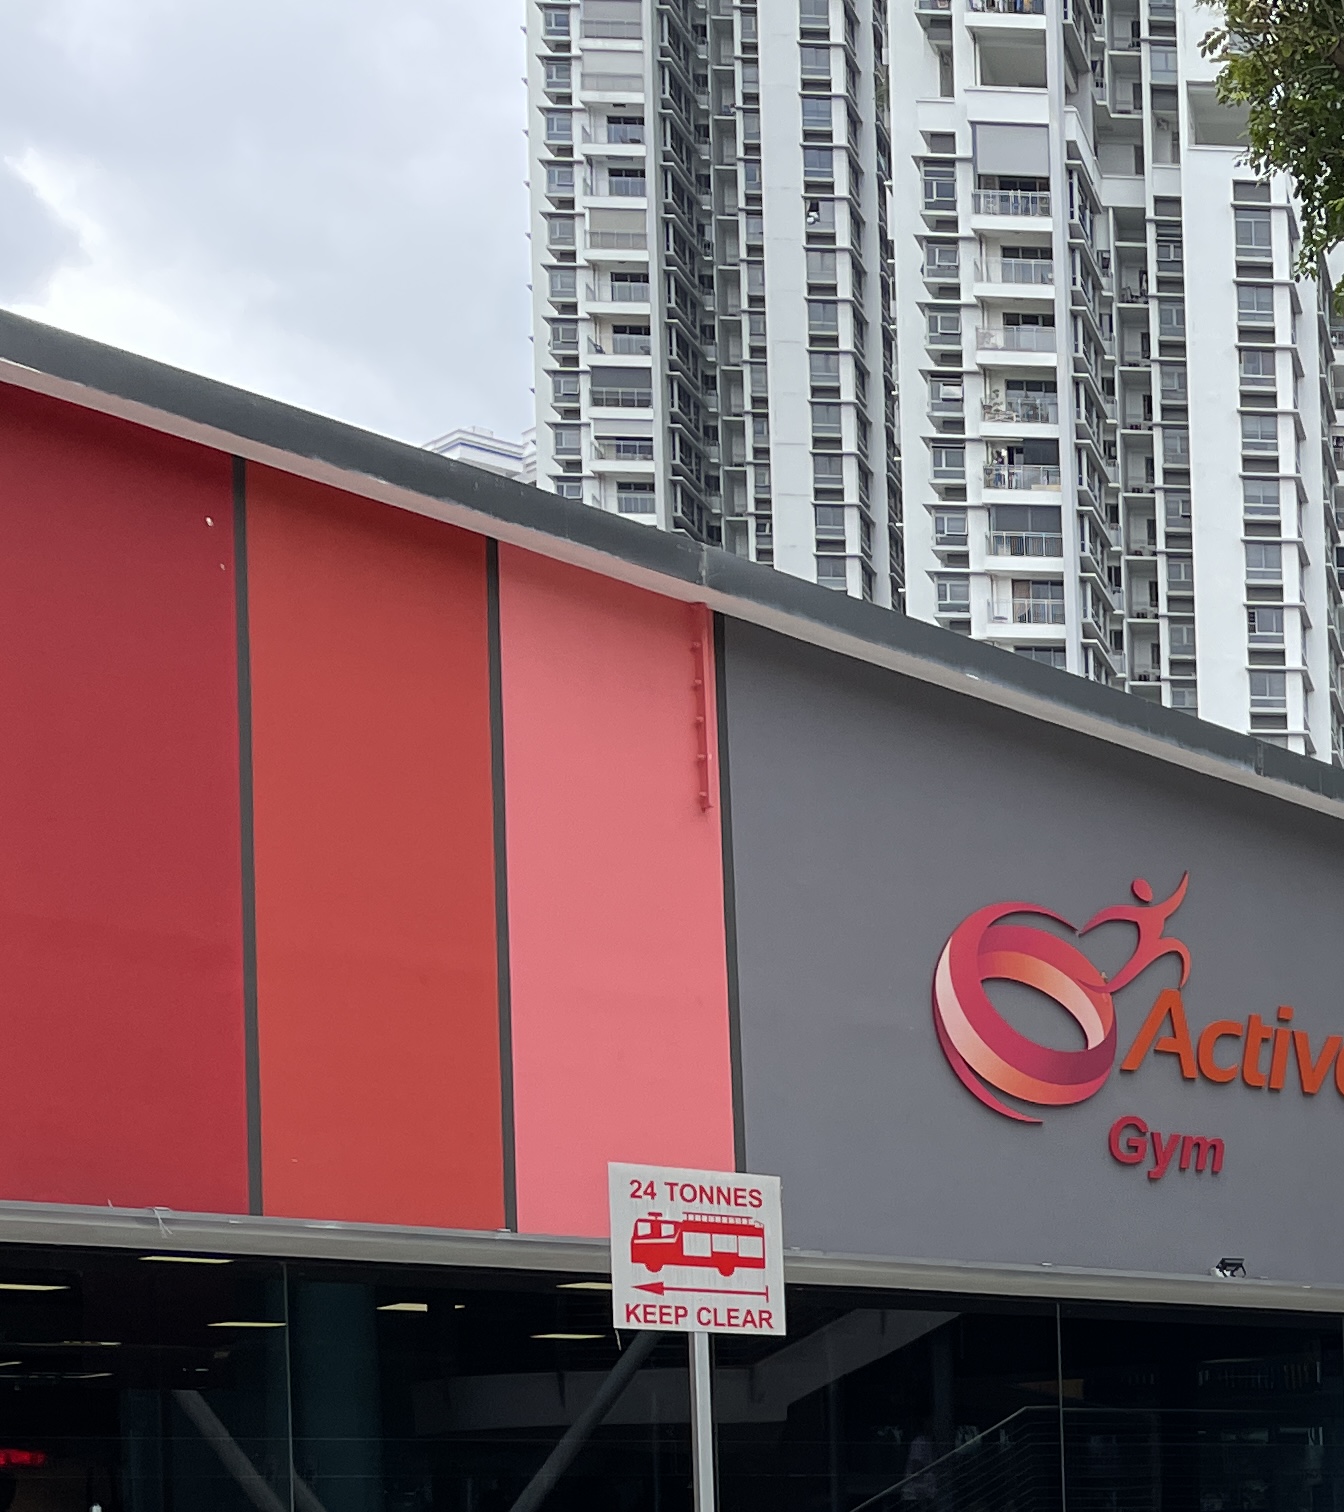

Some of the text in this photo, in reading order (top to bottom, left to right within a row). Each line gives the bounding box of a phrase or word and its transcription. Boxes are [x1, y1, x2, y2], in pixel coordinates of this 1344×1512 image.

[1107, 1115, 1226, 1181] Gym
[629, 1179, 763, 1209] 24 TONNES
[625, 1303, 774, 1329] KEEP CLEAR
